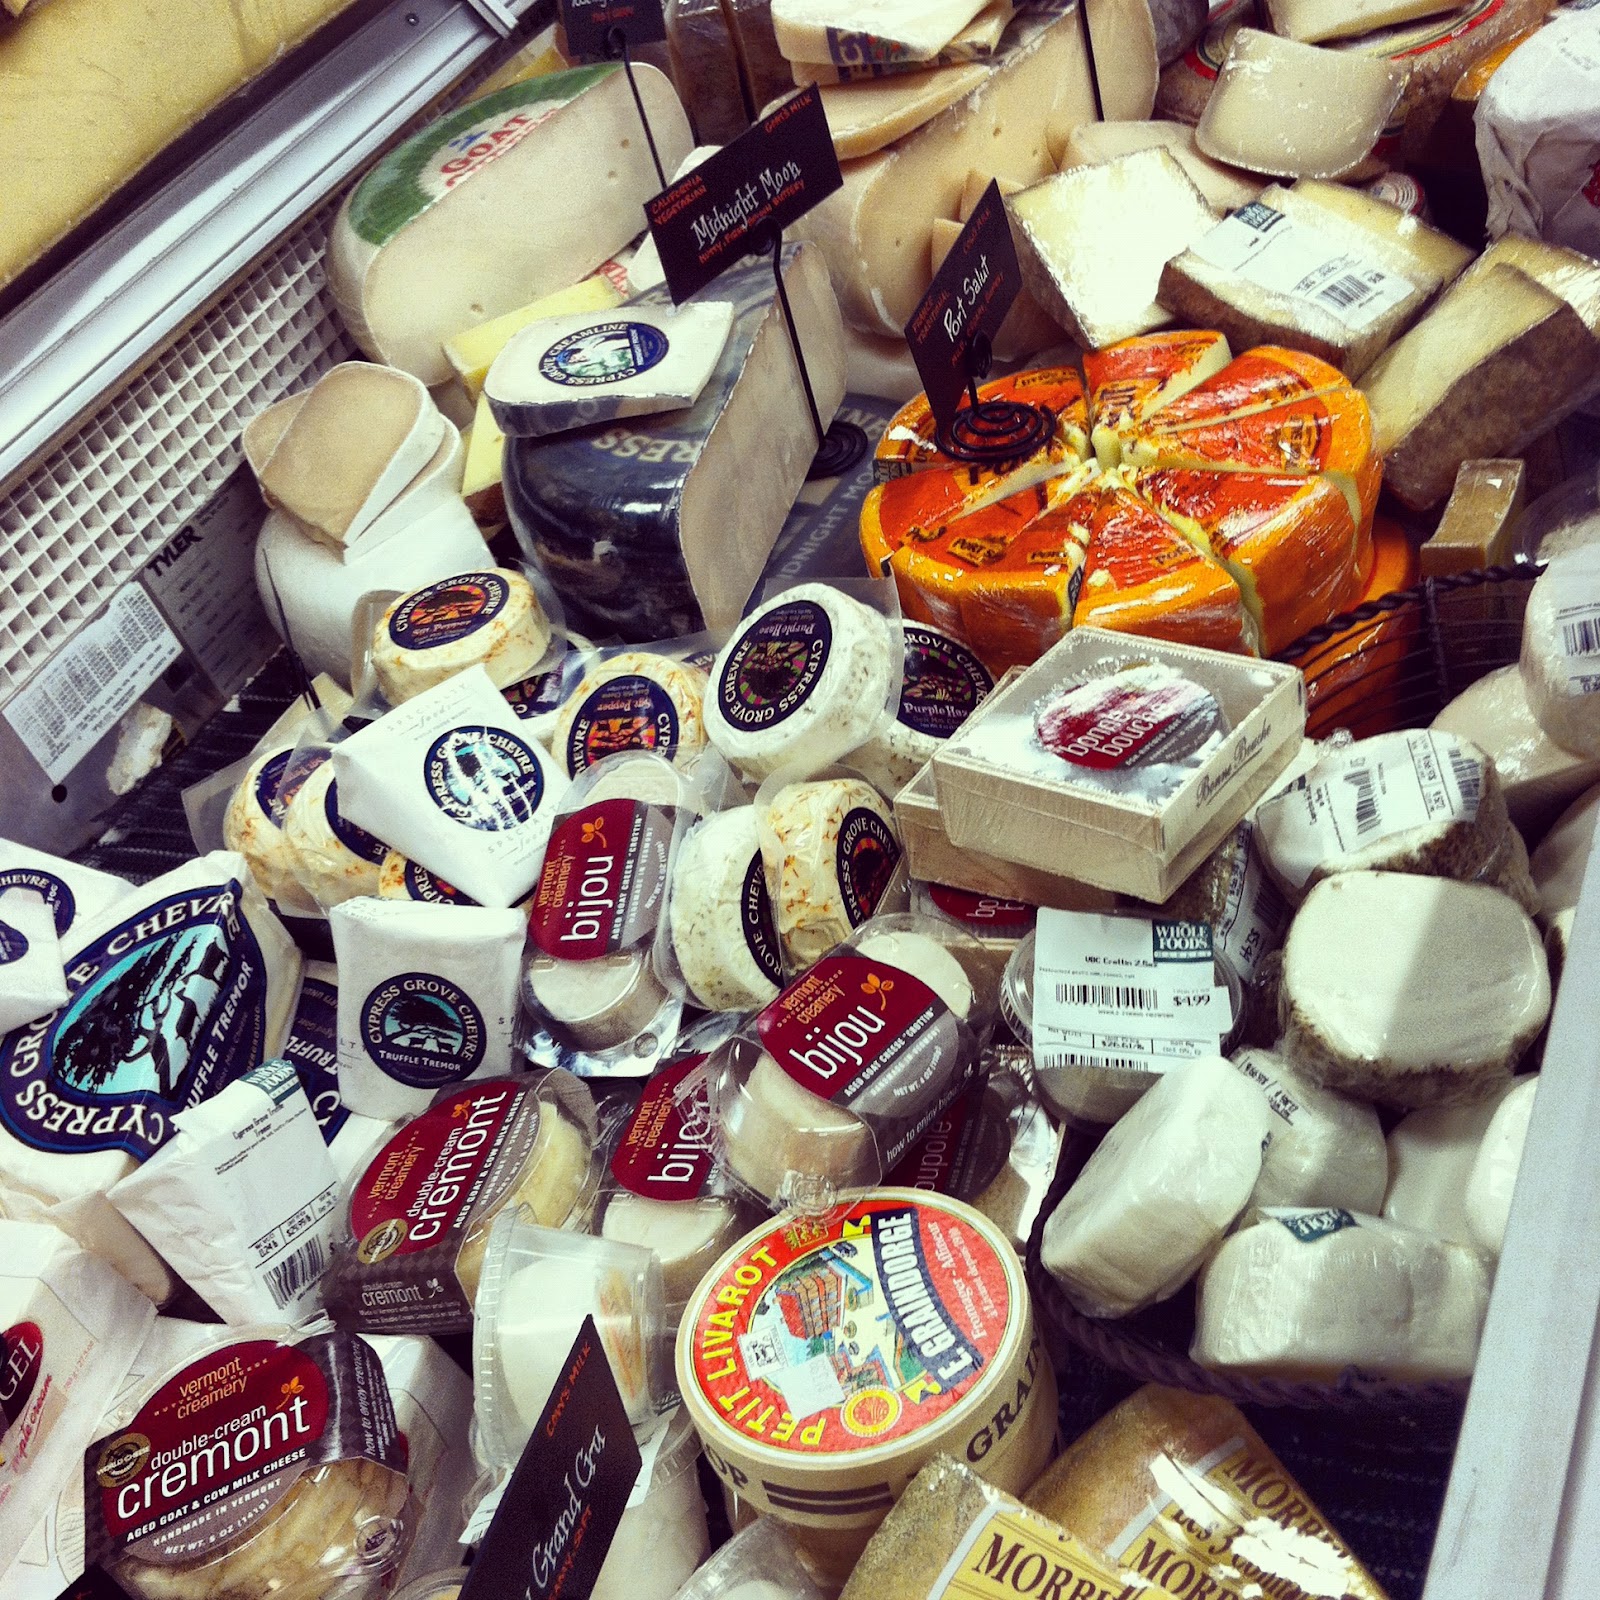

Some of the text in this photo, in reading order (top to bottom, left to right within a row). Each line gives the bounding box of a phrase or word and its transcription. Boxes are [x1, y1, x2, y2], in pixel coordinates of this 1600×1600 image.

[440, 112, 533, 174] GOAT
[651, 174, 702, 215] CALIFORNIA
[655, 184, 707, 226] VEGETARIAN
[690, 160, 802, 250] Midnight Moon
[943, 254, 991, 343] Port Salut
[540, 323, 637, 385] CYPRESS GROVE CREAMLINE
[780, 502, 850, 579] IDNIGHT
[843, 468, 876, 501] MO
[145, 525, 204, 577] TYLER
[436, 576, 488, 591] GROVE
[484, 580, 502, 616] CHEVRE
[782, 622, 816, 635] Purple
[596, 700, 632, 712] Pepper
[725, 638, 823, 724] CHEVRE GROVE CYPRESS
[903, 701, 968, 718] Purple Haz
[487, 733, 535, 775] CHEVRE
[573, 713, 672, 774] CYPR HEVRE
[1195, 765, 1234, 808] Bonne
[0, 874, 50, 889] HEVRE
[538, 859, 557, 908] vermont
[552, 854, 576, 908] creamery
[841, 816, 870, 926] PRESS GROVE
[559, 855, 614, 942] bijou
[748, 865, 783, 977] ROVE CHEV
[1155, 925, 1209, 939] WHOLE
[1159, 937, 1208, 950] FOODS
[366, 984, 401, 1045] CYPRESS
[403, 978, 459, 1005] GROVE
[458, 1004, 481, 1062] CHEVRE
[779, 974, 824, 1013] vermont
[796, 983, 846, 1025] creamery
[1172, 993, 1211, 1007] $4.99
[183, 960, 254, 1113] UFFLE TREMOR
[286, 1035, 339, 1076] TRUFFL
[378, 1049, 462, 1072] TRUFFLE TREMOR
[788, 1005, 886, 1080] bijou
[844, 1077, 864, 1097] AGED
[862, 1060, 882, 1080] GOAT
[879, 1037, 906, 1063] CHEESE
[15, 1079, 165, 1146] CYPRESS
[626, 1100, 656, 1147] vermont
[643, 1097, 673, 1149] creamery
[886, 1105, 938, 1163] how to enjoy
[367, 1151, 404, 1200] vermont
[384, 1146, 426, 1201] creamery
[406, 1127, 463, 1218] double-cream
[408, 1091, 508, 1242] cremont
[452, 1205, 471, 1229] AGED
[466, 1180, 484, 1204] GOAT
[485, 1147, 499, 1170] COW
[494, 1122, 509, 1148] MILK
[505, 1091, 526, 1123] CHEESE
[914, 1120, 952, 1192] oupole
[361, 1284, 424, 1307] cremont
[878, 1212, 957, 1358] GRAINDORGE
[569, 1340, 591, 1386] MILK
[702, 1245, 828, 1446] PETIT LIVAROT
[177, 1373, 249, 1420] creamery
[179, 1356, 243, 1398] vermont
[357, 1385, 370, 1417] enjoy
[150, 1404, 267, 1471] double-cream
[361, 1416, 373, 1430] to
[363, 1429, 377, 1457] how
[117, 1397, 311, 1520] cremont
[126, 1448, 306, 1543] AGED GOAT & COW MILK CHEESE
[152, 1477, 282, 1547] HANDMADE IN VERMONT
[164, 1543, 186, 1555] NET
[218, 1525, 235, 1538] OZ
[532, 1472, 583, 1590] Grand
